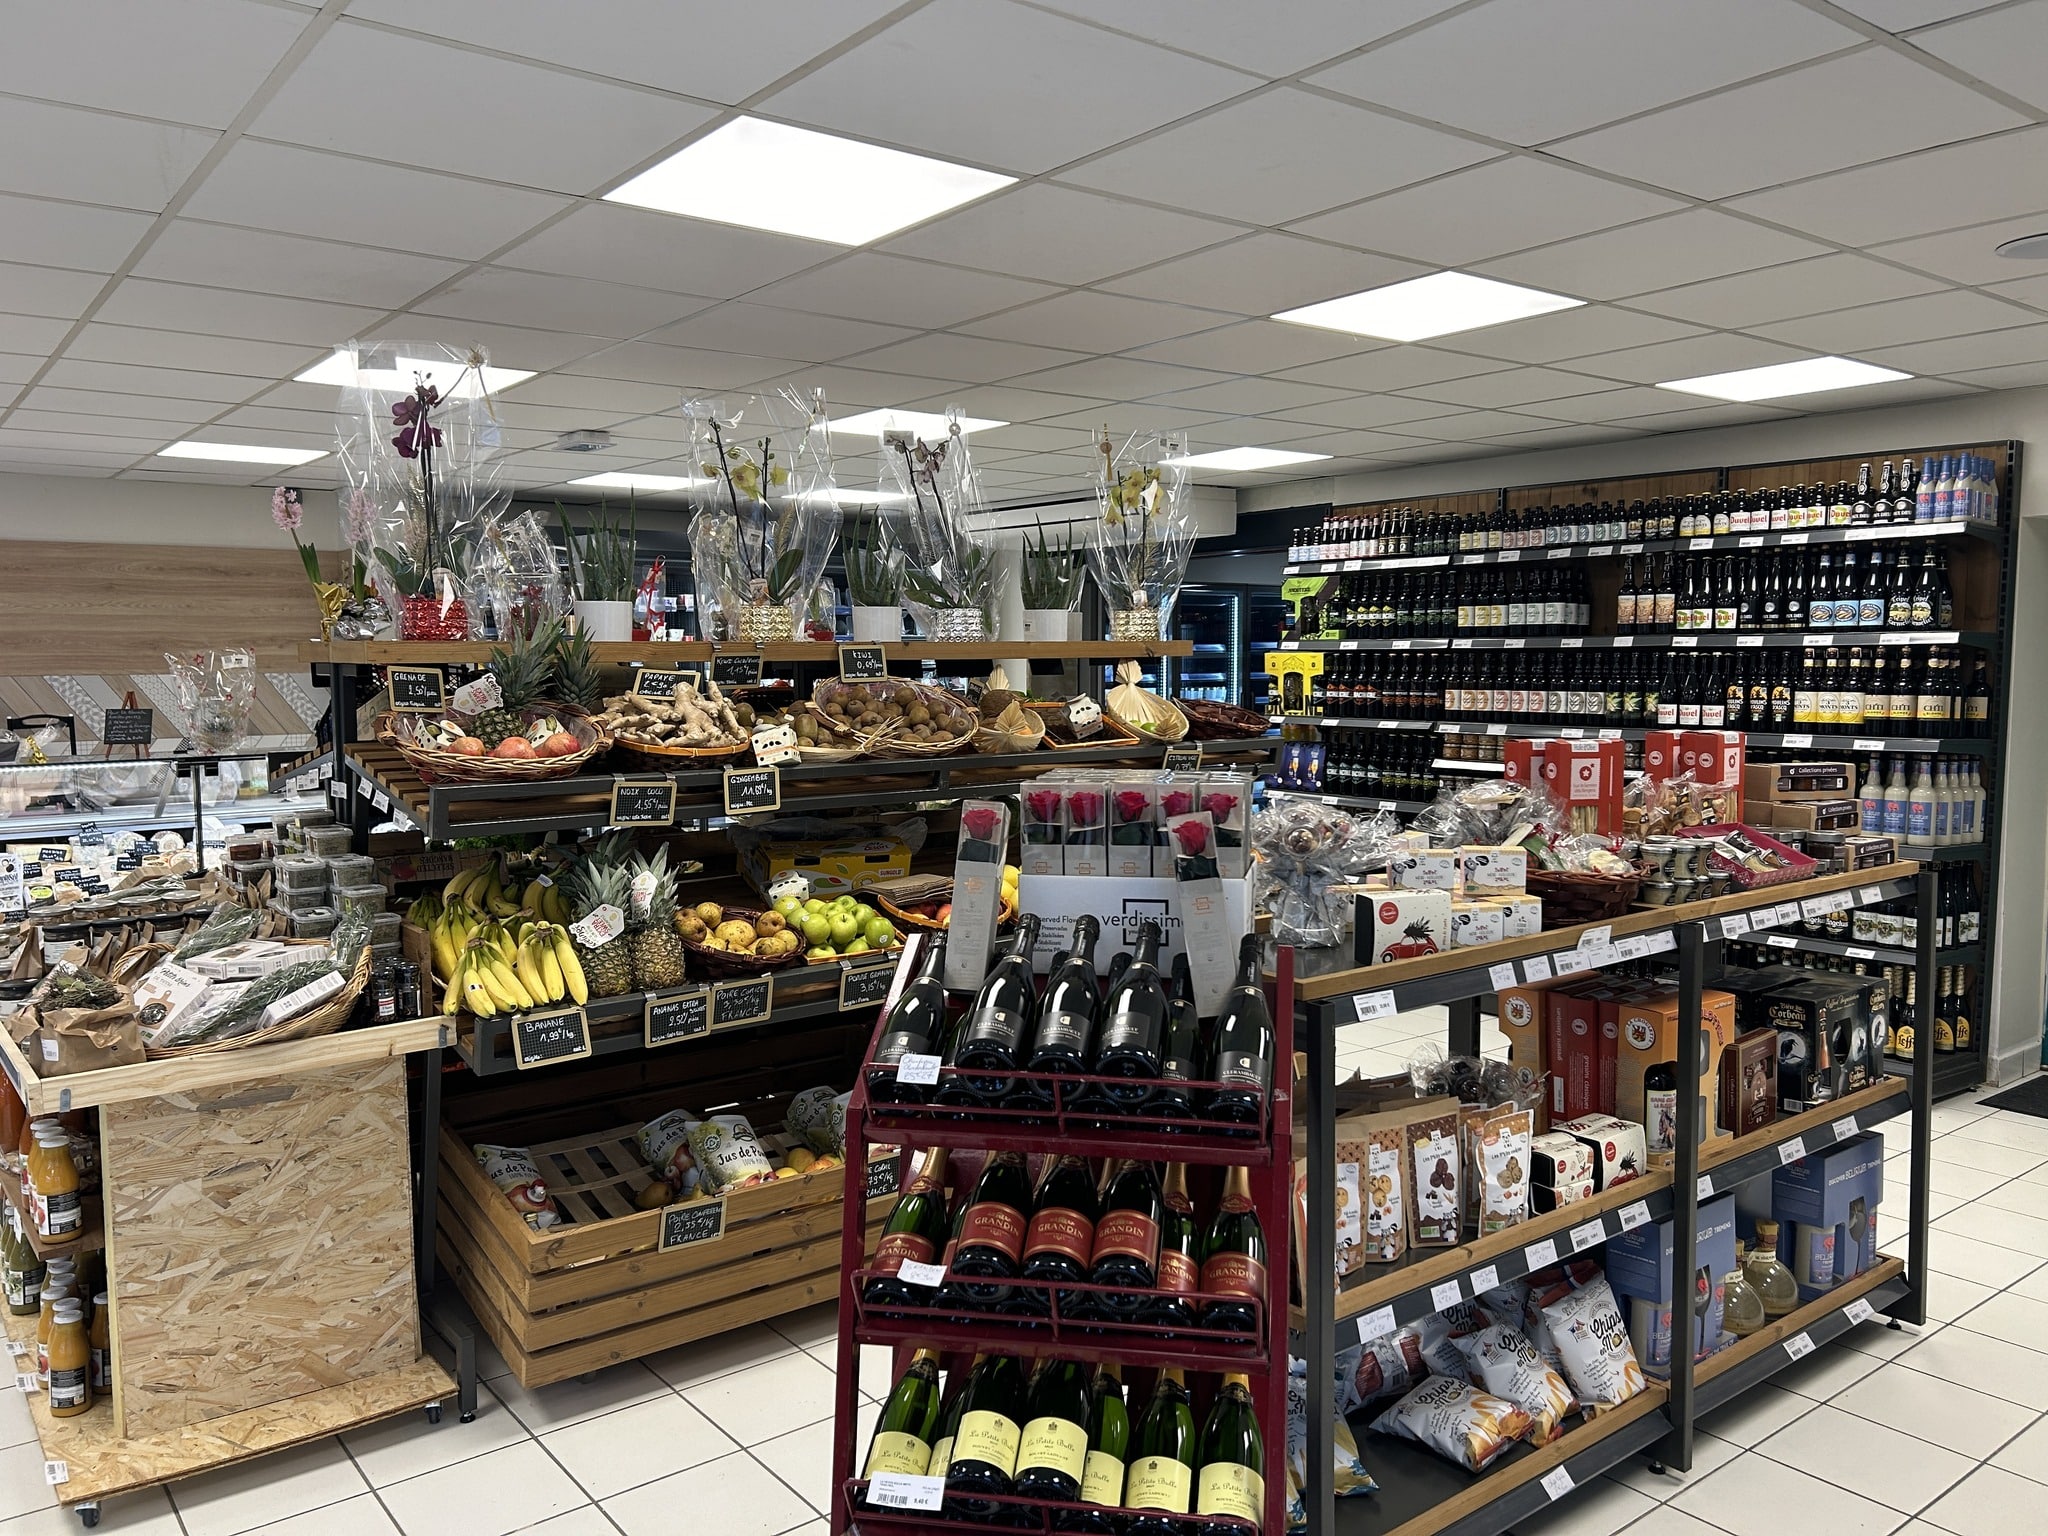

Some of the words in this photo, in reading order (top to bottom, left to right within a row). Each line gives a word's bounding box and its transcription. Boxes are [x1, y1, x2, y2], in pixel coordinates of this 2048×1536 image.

[394, 672, 426, 681] GRENADE
[644, 673, 676, 681] PAPAYE
[730, 773, 768, 784] GINGEMBRE
[1102, 909, 1184, 928] verdissim
[653, 1003, 680, 1016] ANANAS
[721, 1006, 759, 1021] FRANCE
[1768, 1006, 1806, 1021] Corbeau
[525, 1017, 565, 1032] BANANE
[1897, 1034, 1915, 1049] Leff
[652, 1140, 666, 1158] Jus
[717, 1152, 738, 1166] Jus
[738, 1146, 752, 1158] de
[490, 1168, 504, 1179] us
[505, 1163, 519, 1174] de
[669, 1212, 690, 1225] POIRE
[974, 1216, 1020, 1237] GRANDIN
[1037, 1223, 1085, 1239] GRANDIN
[1098, 1225, 1145, 1238] GRANDIN
[670, 1230, 708, 1246] FRANCE
[876, 1247, 920, 1260] GRANDIN
[1159, 1265, 1195, 1284] RANDIN
[1209, 1266, 1257, 1281] GRANDIN
[1589, 1311, 1622, 1339] Chips
[1414, 1379, 1455, 1405] Chips
[1036, 1436, 1054, 1445] Petite
